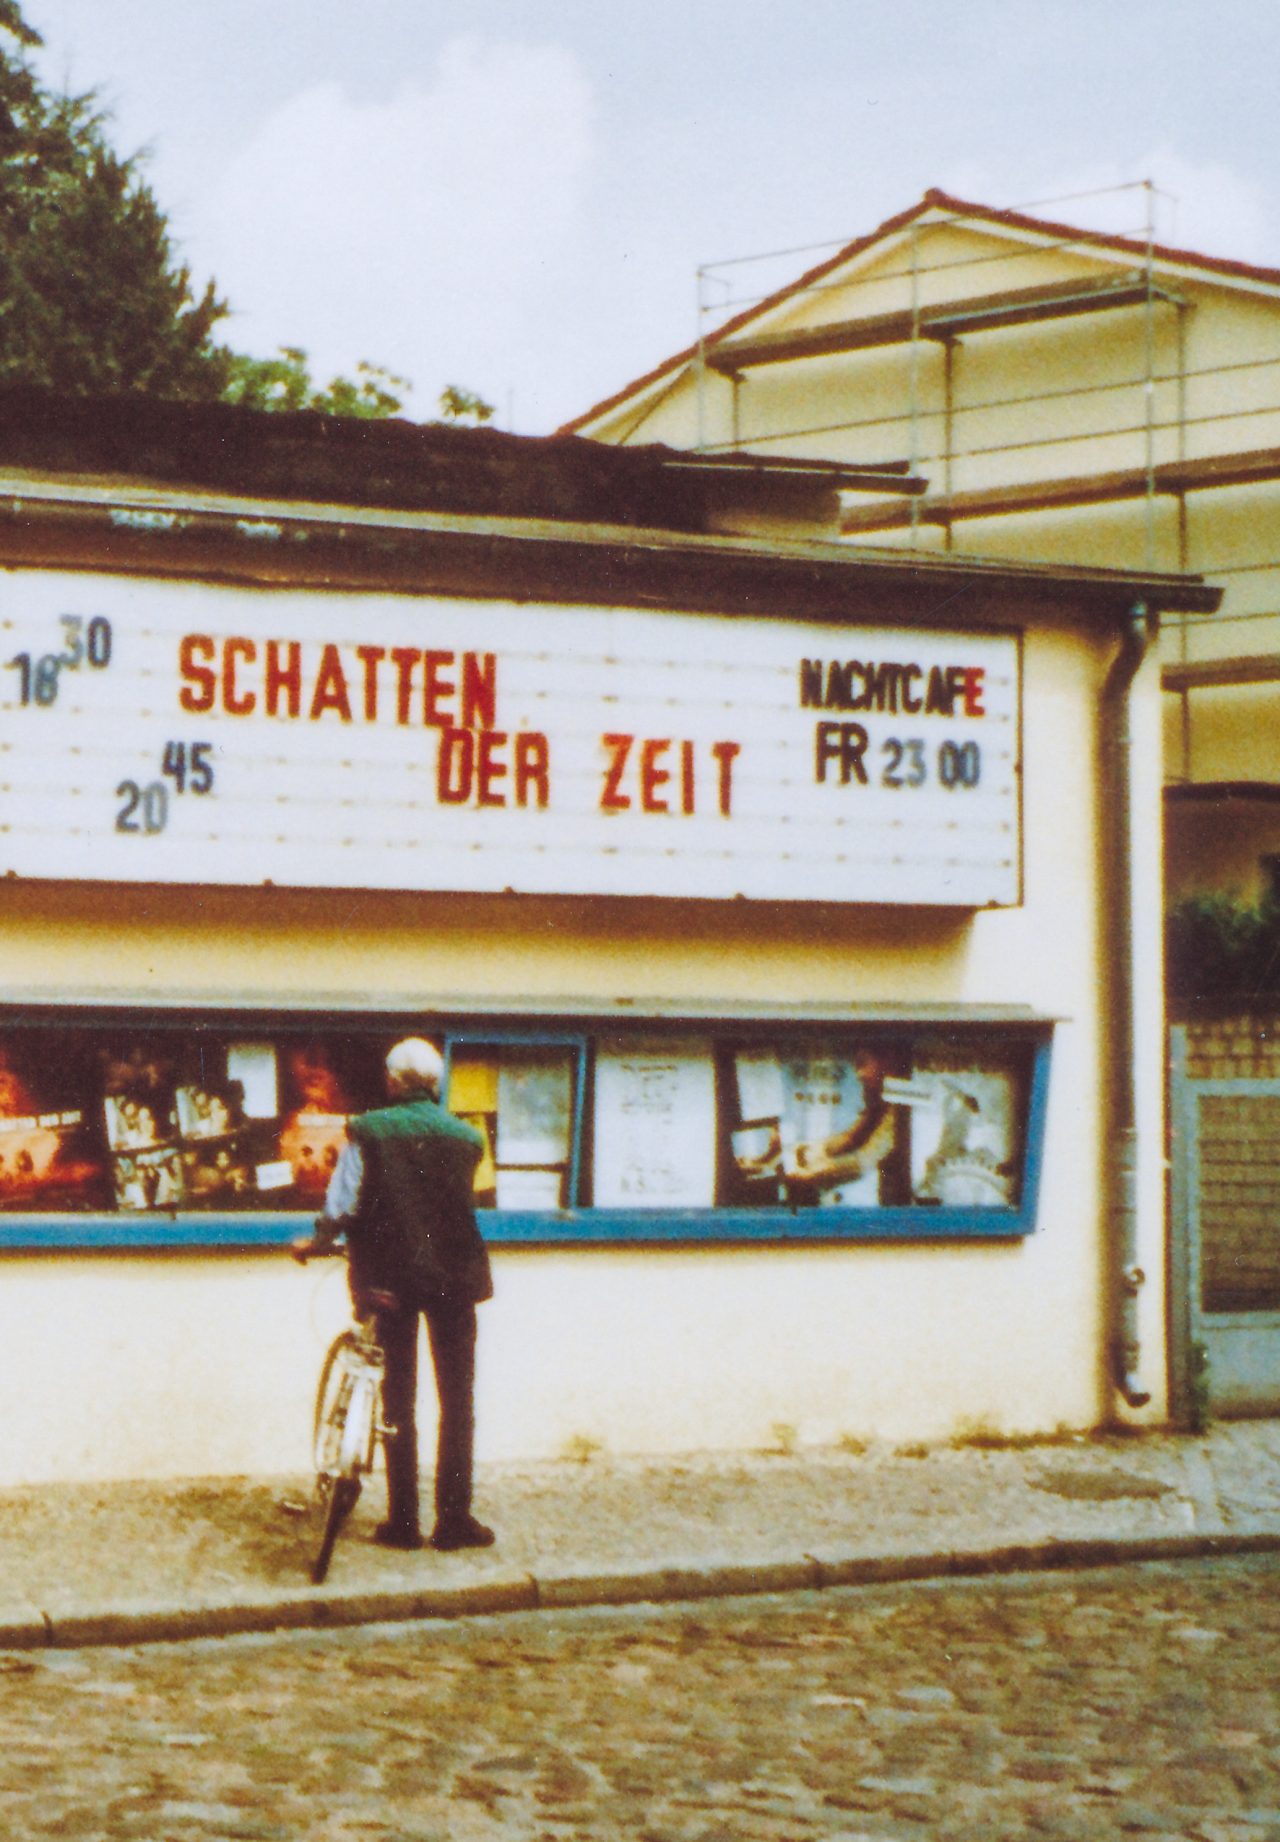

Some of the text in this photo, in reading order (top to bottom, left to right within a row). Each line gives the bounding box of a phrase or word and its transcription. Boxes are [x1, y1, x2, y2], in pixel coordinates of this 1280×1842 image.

[13, 613, 112, 707] 18 30
[179, 633, 497, 728] SCHATTEN
[800, 657, 986, 717] NACHTCAFE
[115, 740, 214, 836] 20 45
[437, 728, 741, 818] DER ZEIT
[816, 720, 981, 791] FR 23 00
